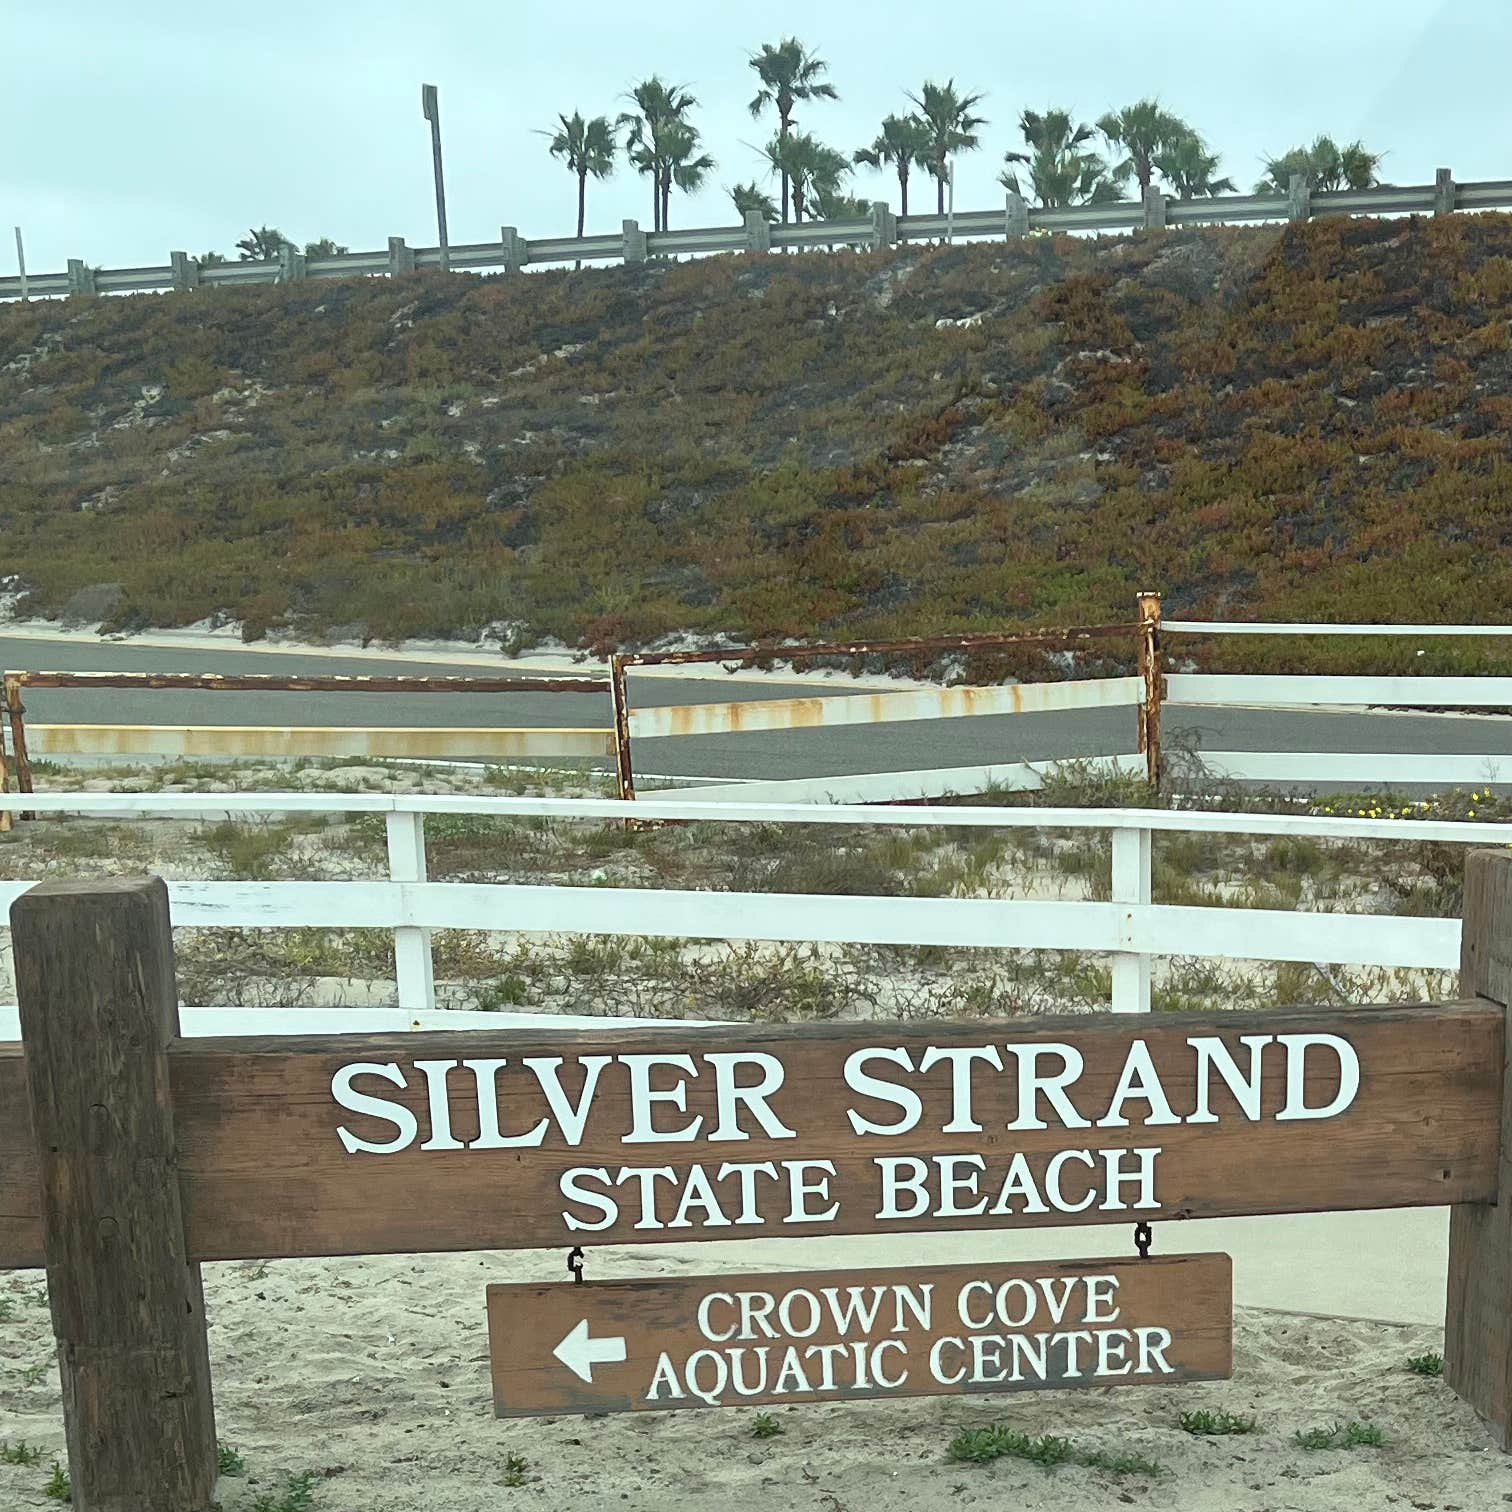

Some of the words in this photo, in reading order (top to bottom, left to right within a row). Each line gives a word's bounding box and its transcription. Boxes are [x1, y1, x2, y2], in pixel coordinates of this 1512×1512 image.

[331, 1052, 797, 1154] SILVER
[843, 1033, 1360, 1136] STRAND
[559, 1159, 840, 1231] STATE
[873, 1147, 1162, 1219] BEACH
[697, 1283, 934, 1342] CROWN
[957, 1274, 1120, 1329] COVE
[645, 1339, 908, 1406] AQUATIC
[929, 1326, 1175, 1385] CENTER
